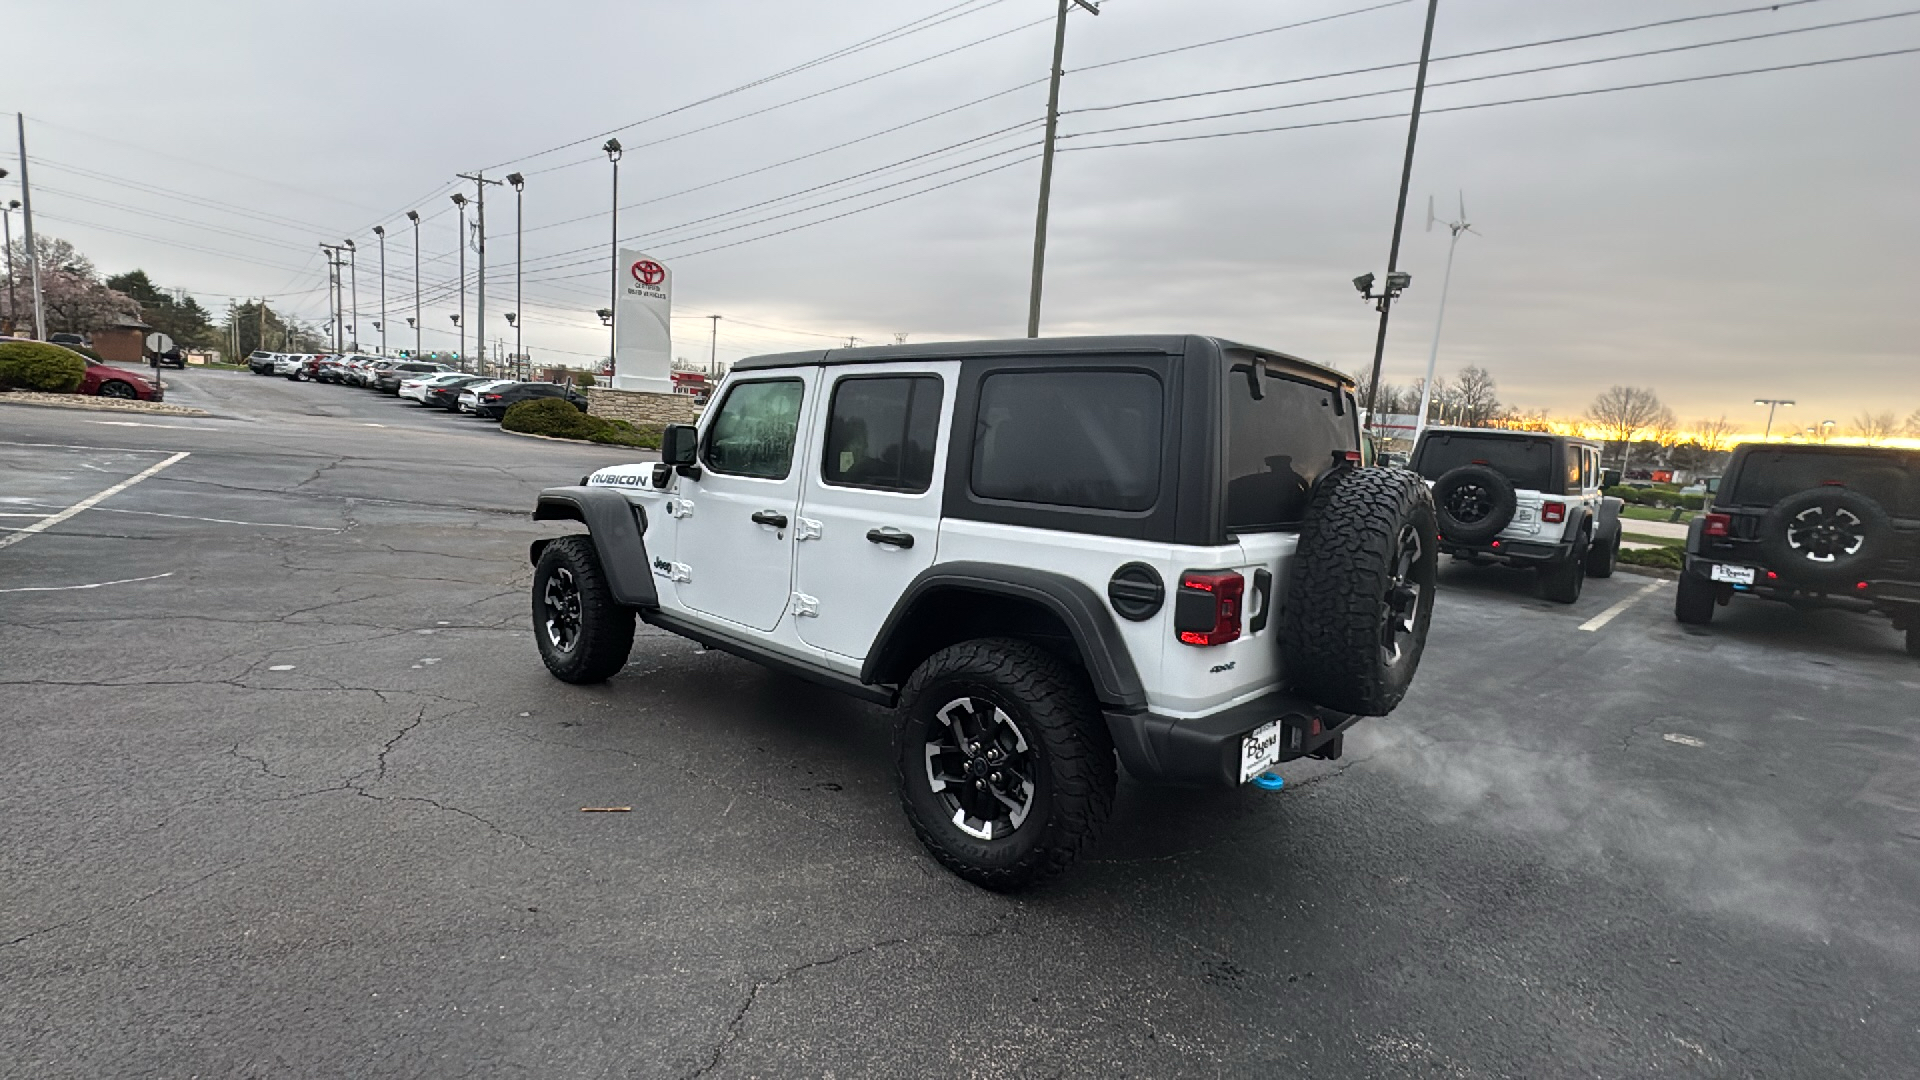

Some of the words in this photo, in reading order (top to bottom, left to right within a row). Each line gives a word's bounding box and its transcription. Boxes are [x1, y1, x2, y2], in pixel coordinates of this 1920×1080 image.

[627, 287, 643, 296] USED
[643, 291, 667, 300] VEHICLES
[591, 473, 649, 487] RUBICON
[653, 556, 672, 574] Jeep
